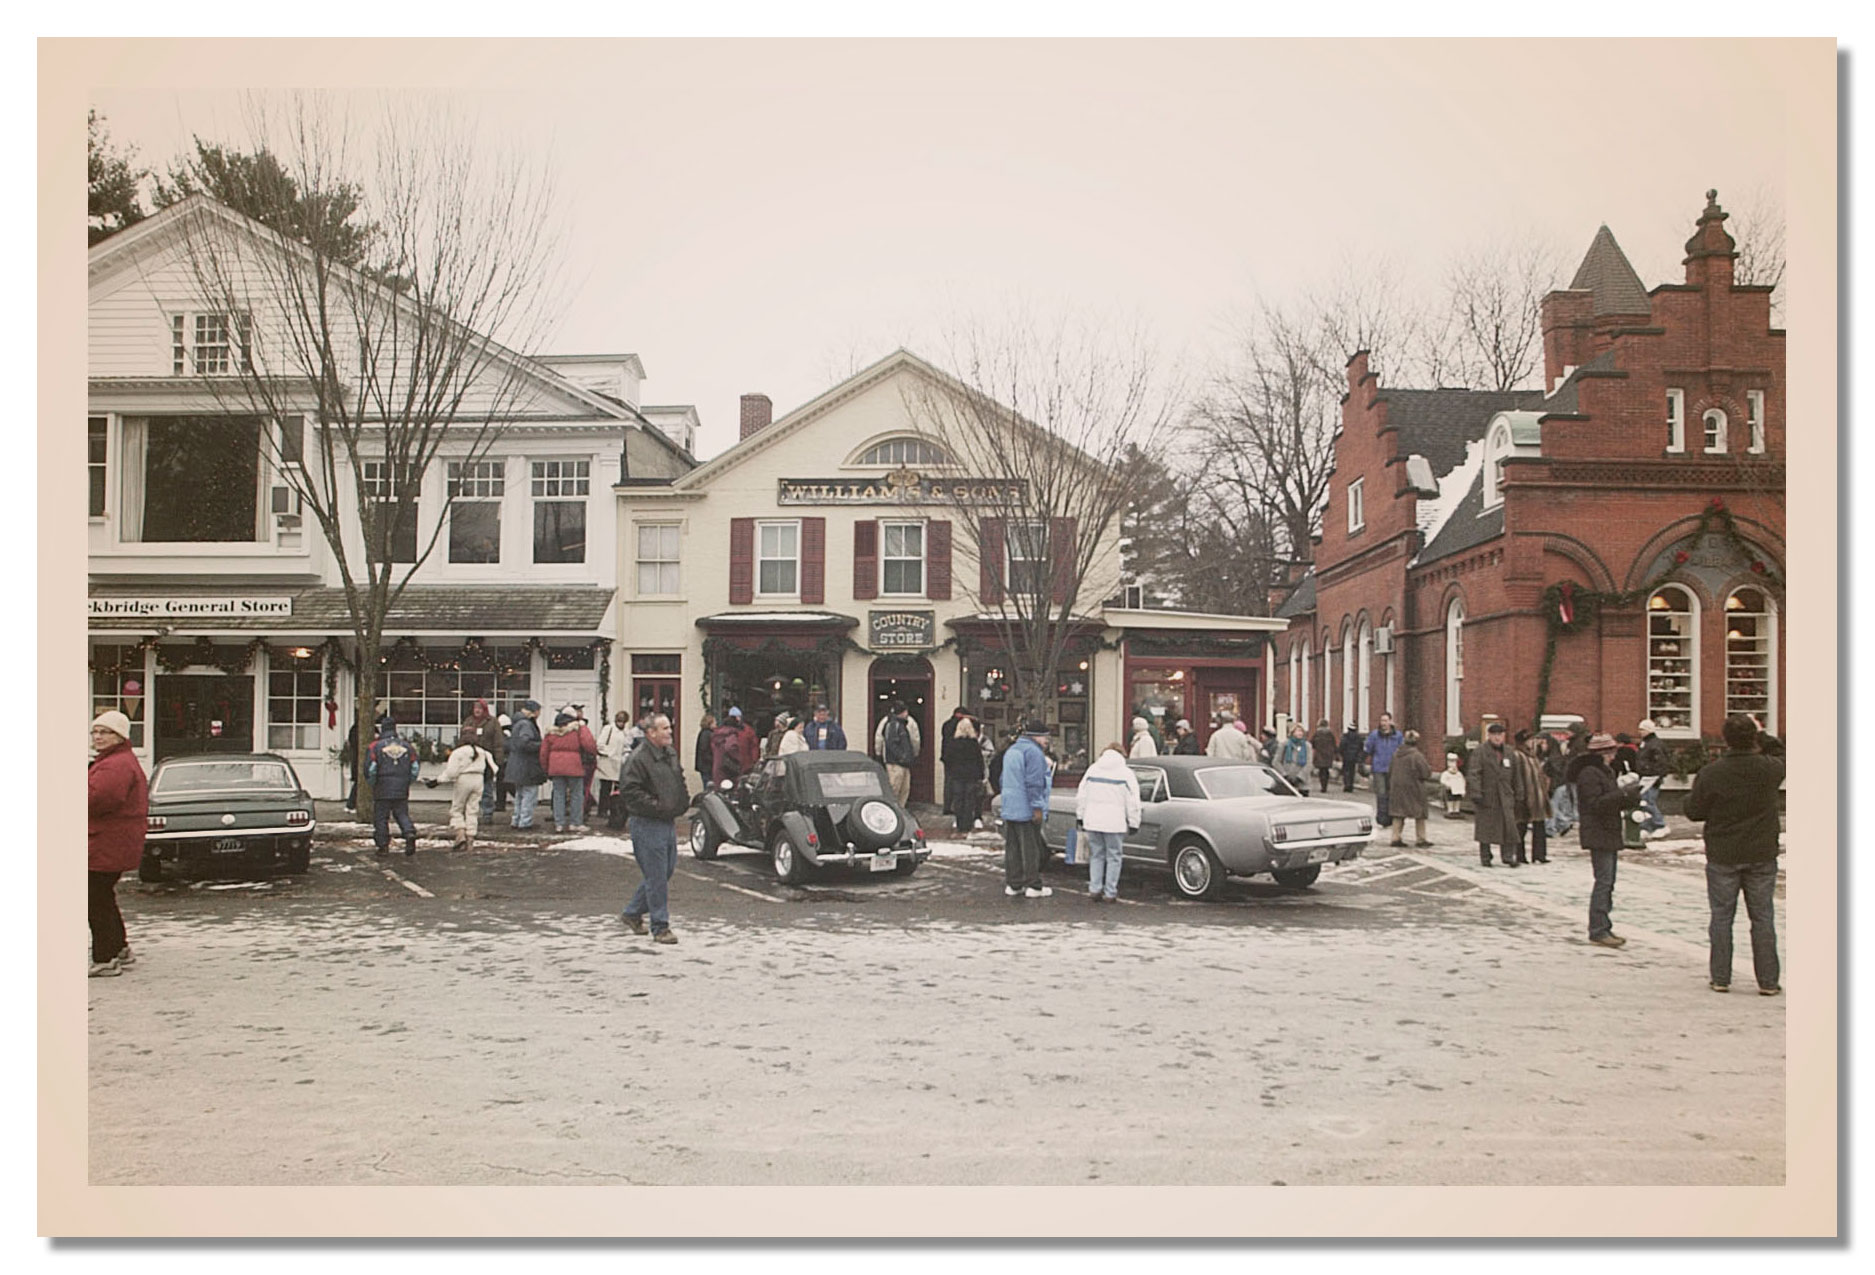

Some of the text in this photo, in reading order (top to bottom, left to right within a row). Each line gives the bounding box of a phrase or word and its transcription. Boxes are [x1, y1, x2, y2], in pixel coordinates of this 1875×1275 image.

[930, 485, 943, 499] &
[165, 600, 235, 613] General
[240, 600, 289, 613] Store
[872, 614, 930, 631] COUNTRY
[880, 633, 923, 644] STORE
